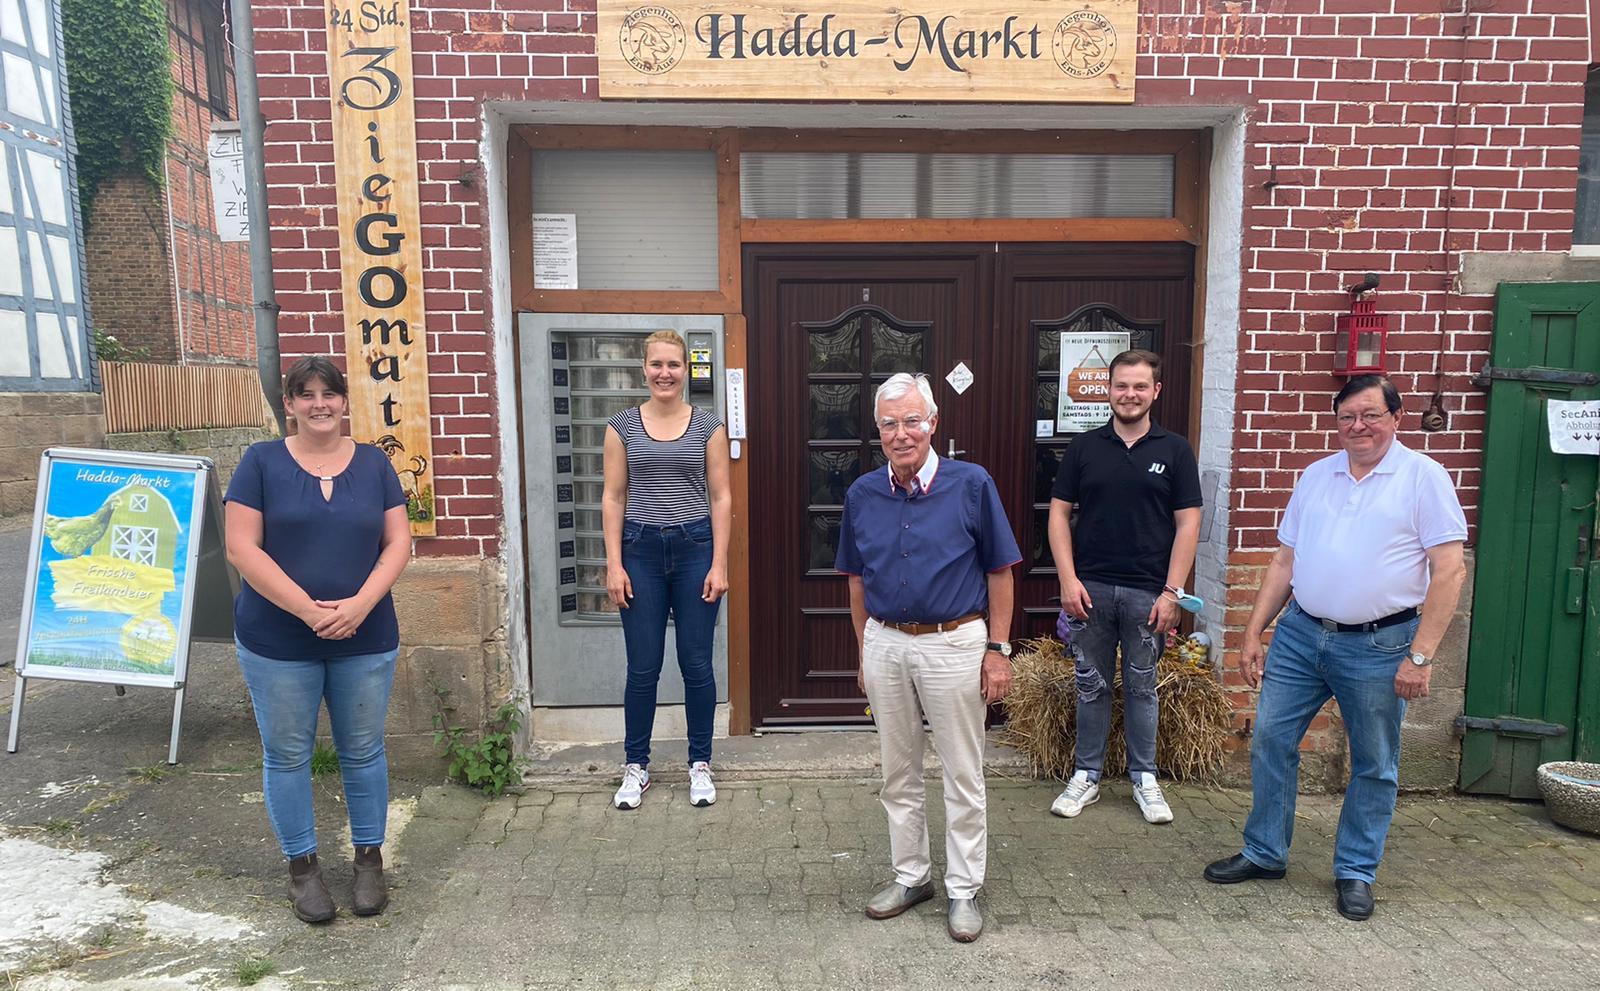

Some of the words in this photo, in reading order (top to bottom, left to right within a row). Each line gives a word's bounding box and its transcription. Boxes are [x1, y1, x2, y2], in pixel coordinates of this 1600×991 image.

[330, 8, 353, 32] 24
[359, 1, 404, 33] Std.
[695, 13, 1042, 72] Hadda-Markt
[1061, 61, 1106, 76] Ems-Aue
[1078, 372, 1092, 380] WE
[1078, 385, 1109, 395] OPEN
[1148, 462, 1166, 474] JU
[76, 468, 171, 488] Hadda-Markt
[88, 564, 137, 580] Frische
[72, 582, 154, 600] Freilandeier
